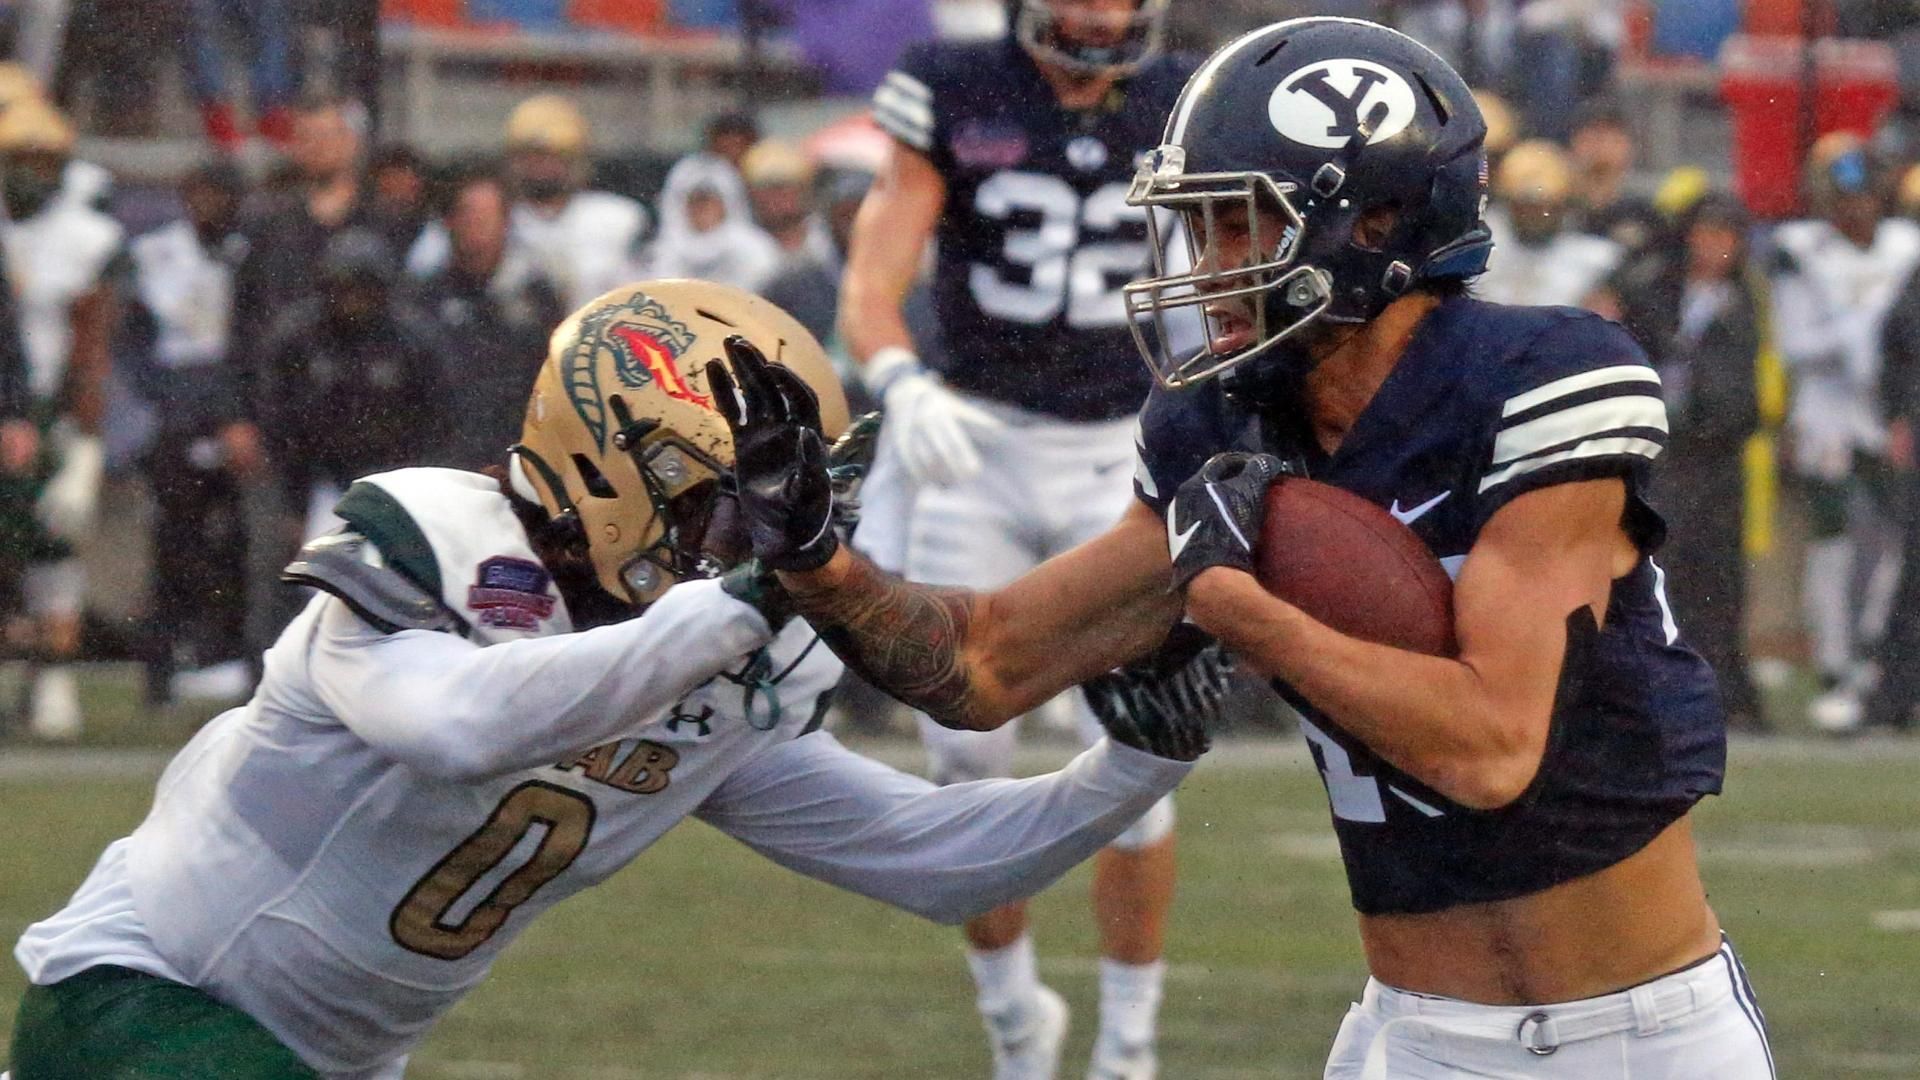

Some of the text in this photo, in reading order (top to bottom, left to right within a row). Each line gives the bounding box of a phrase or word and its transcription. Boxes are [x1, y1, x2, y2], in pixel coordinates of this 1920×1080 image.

[1286, 66, 1388, 137] Y
[968, 170, 1174, 328] 32
[554, 738, 680, 794] AB
[389, 779, 597, 961] 0
